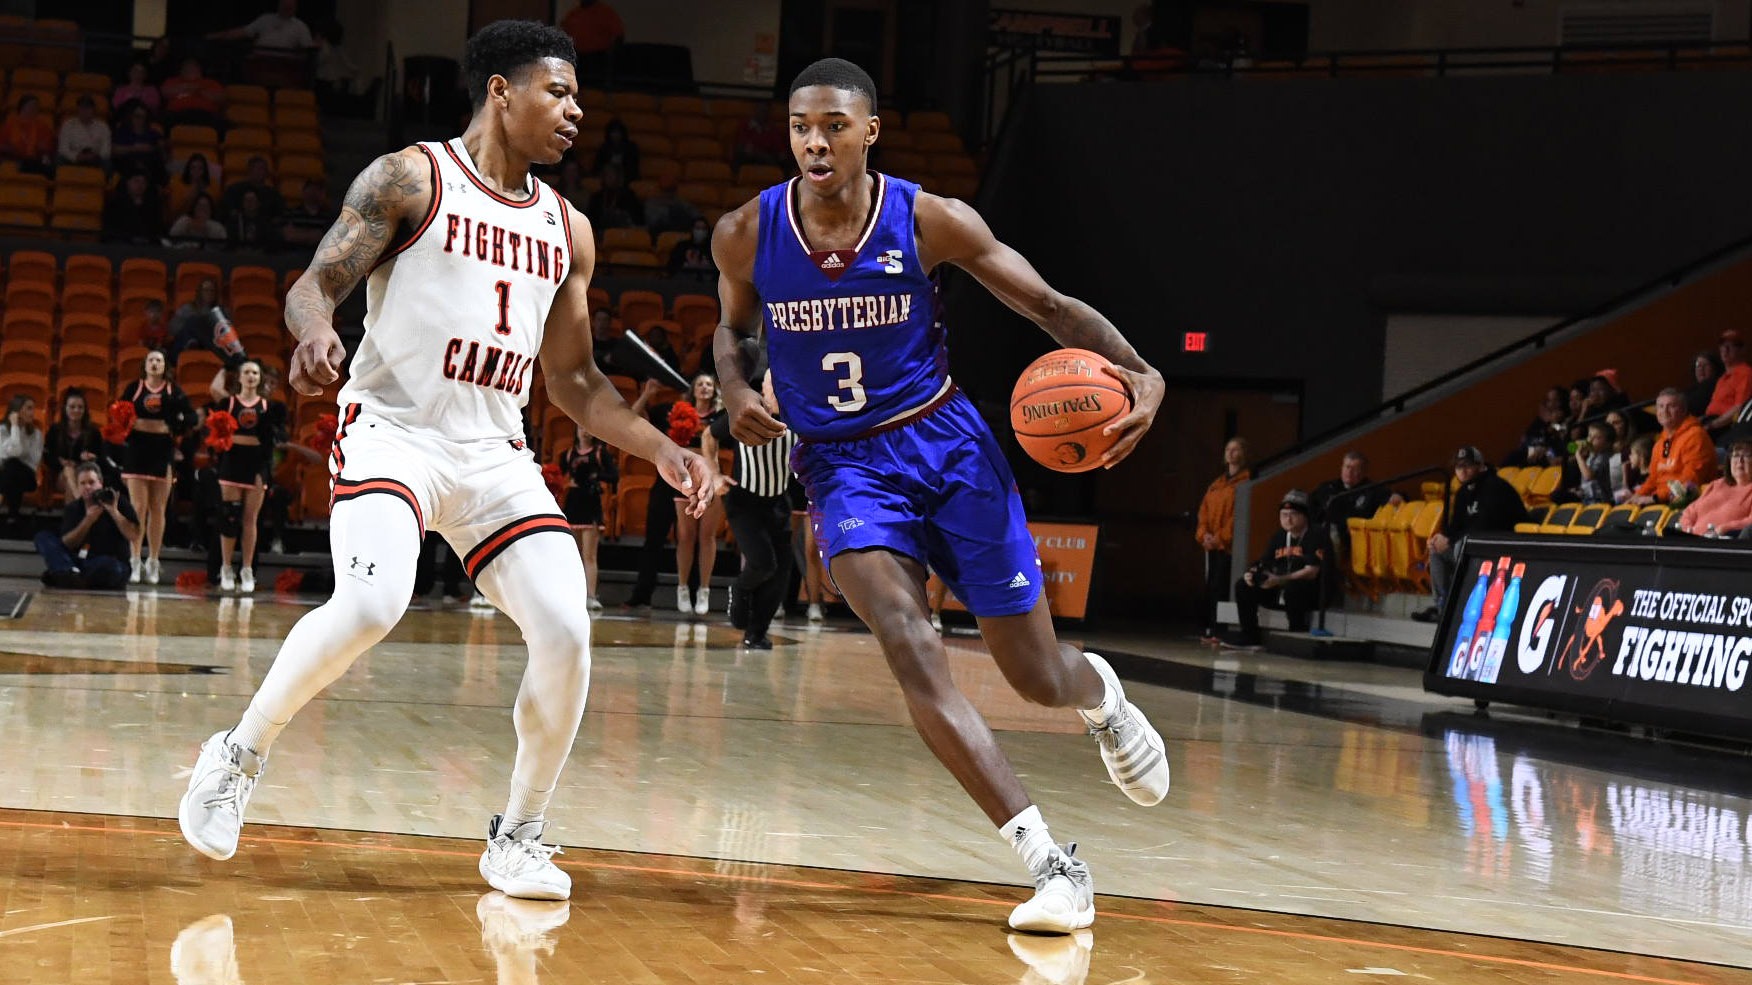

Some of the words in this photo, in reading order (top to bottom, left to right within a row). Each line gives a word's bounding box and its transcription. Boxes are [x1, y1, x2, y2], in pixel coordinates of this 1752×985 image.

[443, 213, 565, 285] FIGHTING
[494, 279, 512, 336] 1
[767, 294, 912, 332] PRESBYTERIAN
[442, 337, 533, 396] CAMELS
[1185, 331, 1207, 351] EXIT
[822, 351, 867, 412] 3
[1022, 392, 1102, 424] SPALDING
[1046, 537, 1086, 549] CLUB
[1517, 574, 1568, 674] G
[1631, 589, 1662, 619] THE
[1660, 591, 1728, 625] OFFICIAL
[1611, 625, 1752, 692] FIGHTING
